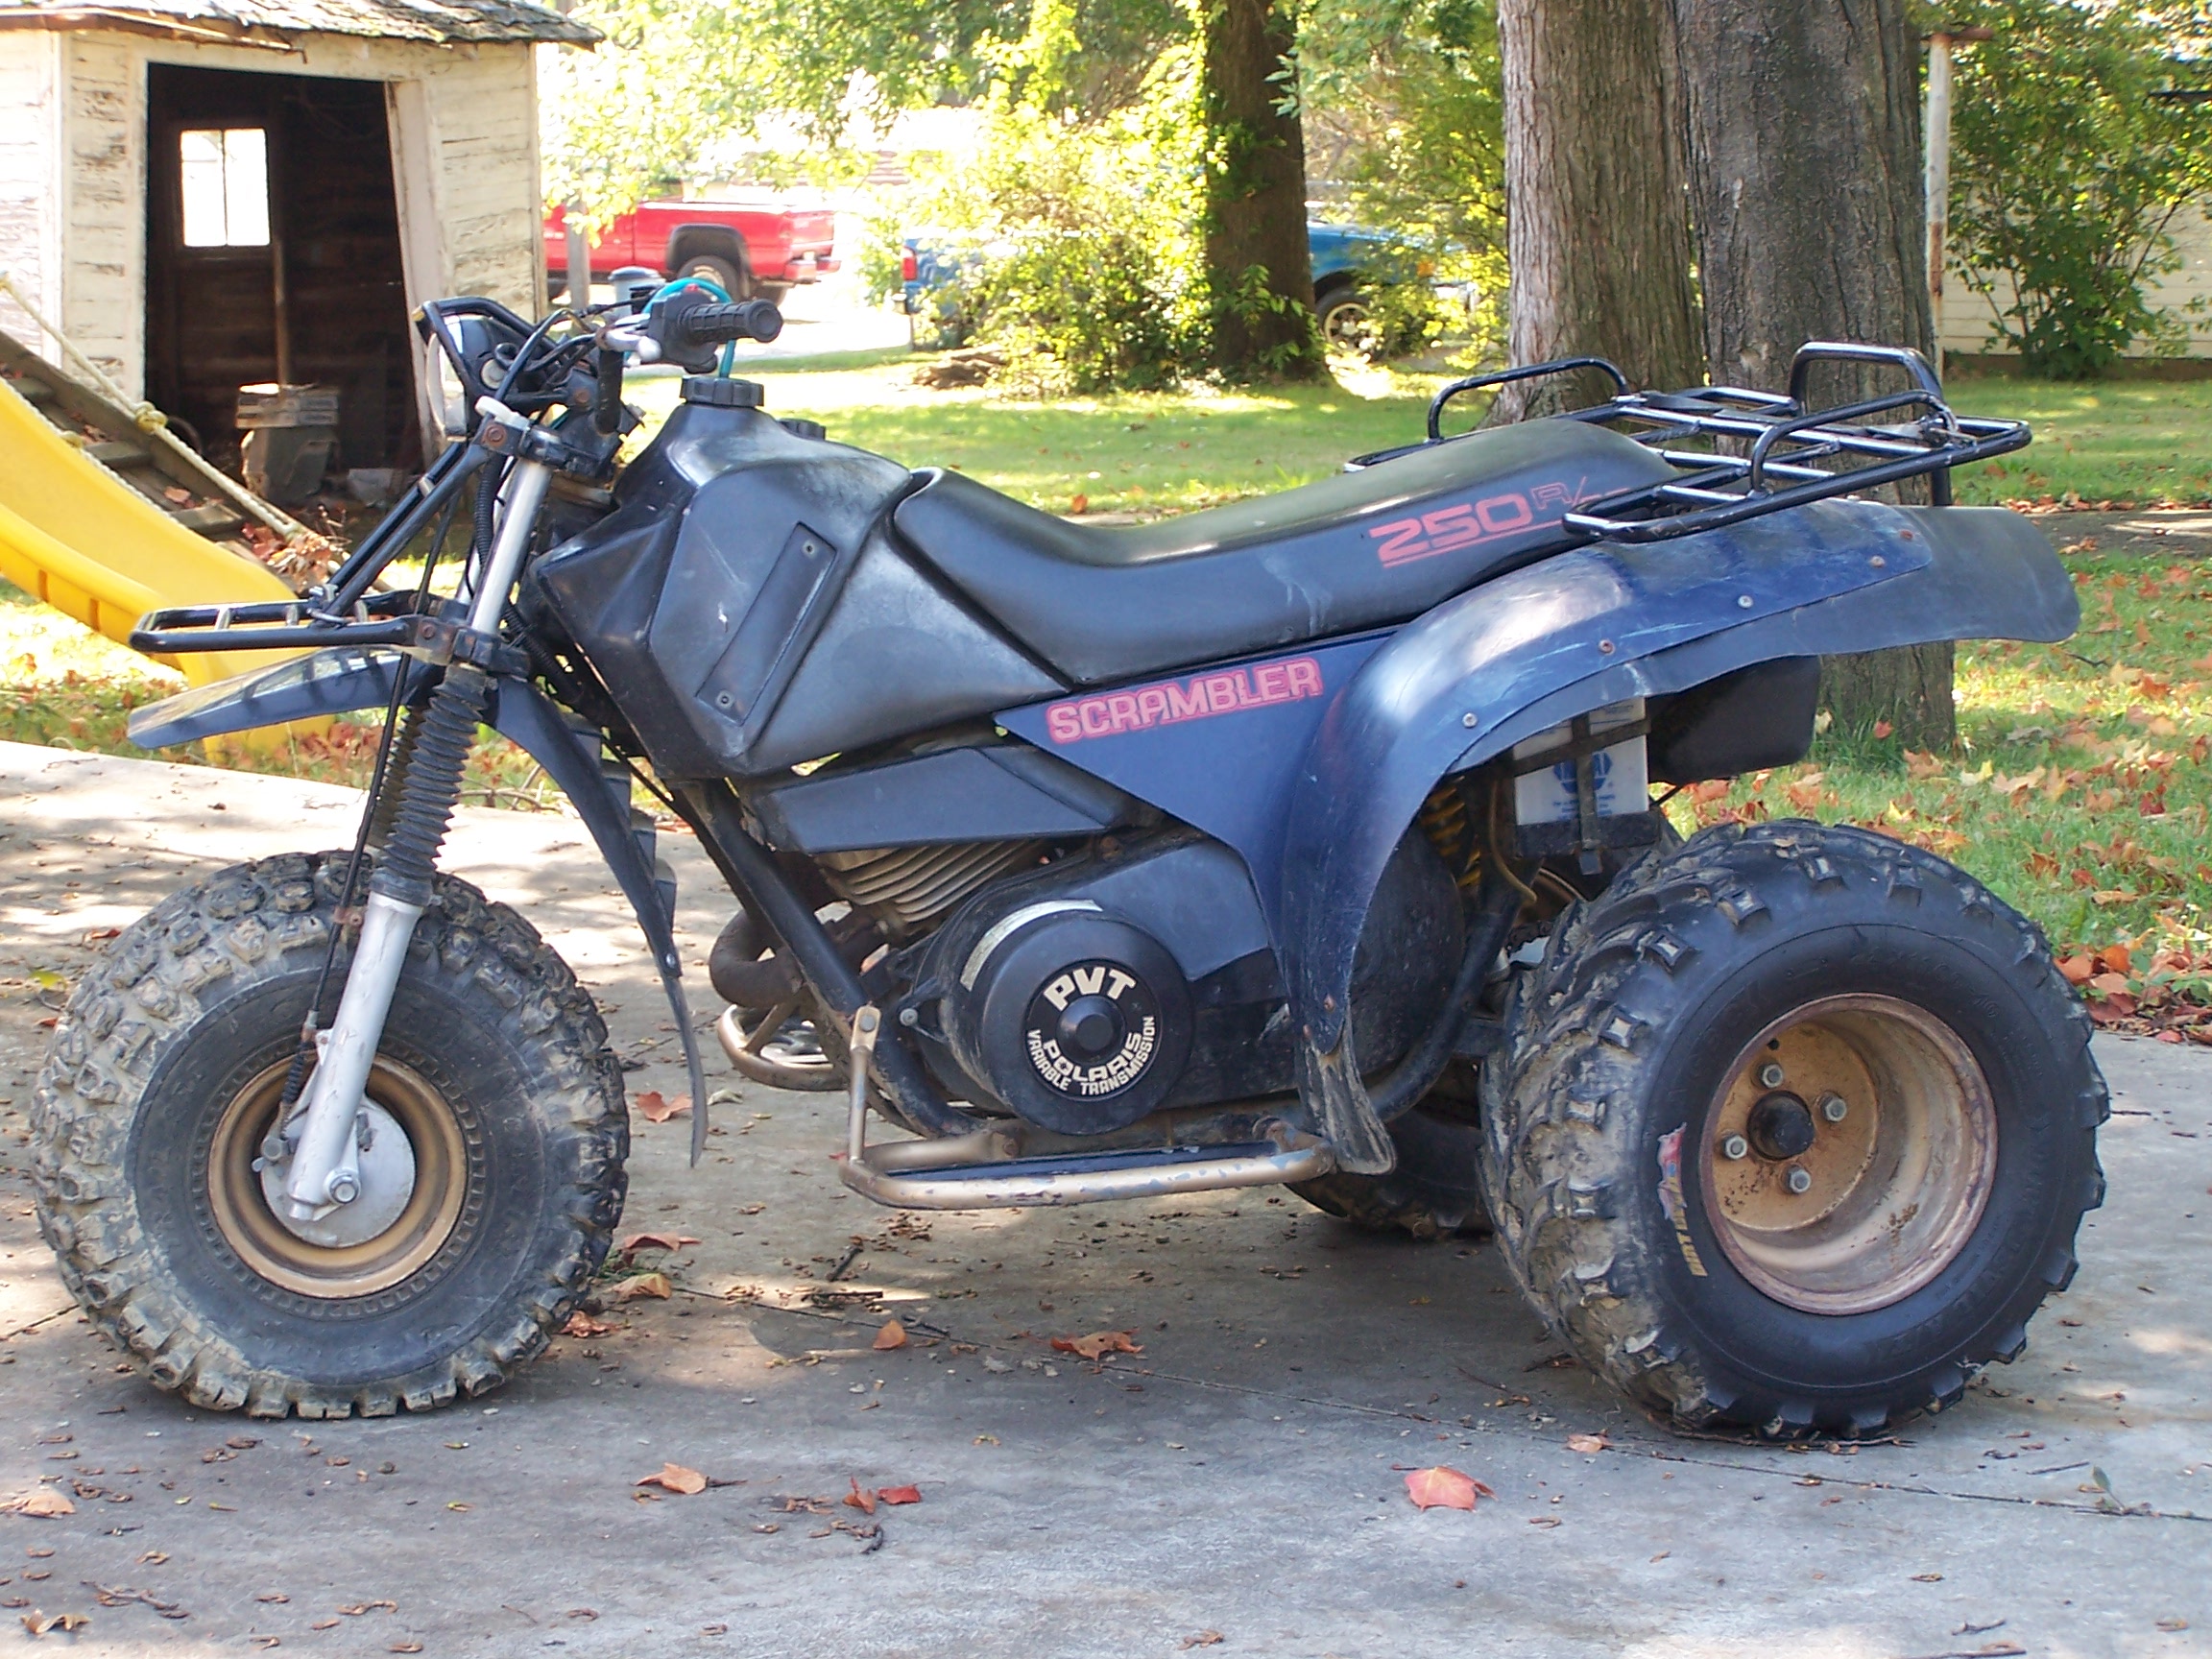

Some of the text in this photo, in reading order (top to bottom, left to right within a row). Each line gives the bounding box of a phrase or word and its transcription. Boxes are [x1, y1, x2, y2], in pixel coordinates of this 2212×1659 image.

[1369, 493, 1533, 564] 250
[1046, 657, 1324, 744] SCRAMBLER
[1043, 966, 1137, 1011] PVT
[1027, 1016, 1156, 1095] VARIABLE TRANSMISSION
[1043, 1032, 1142, 1082] POLARIS
